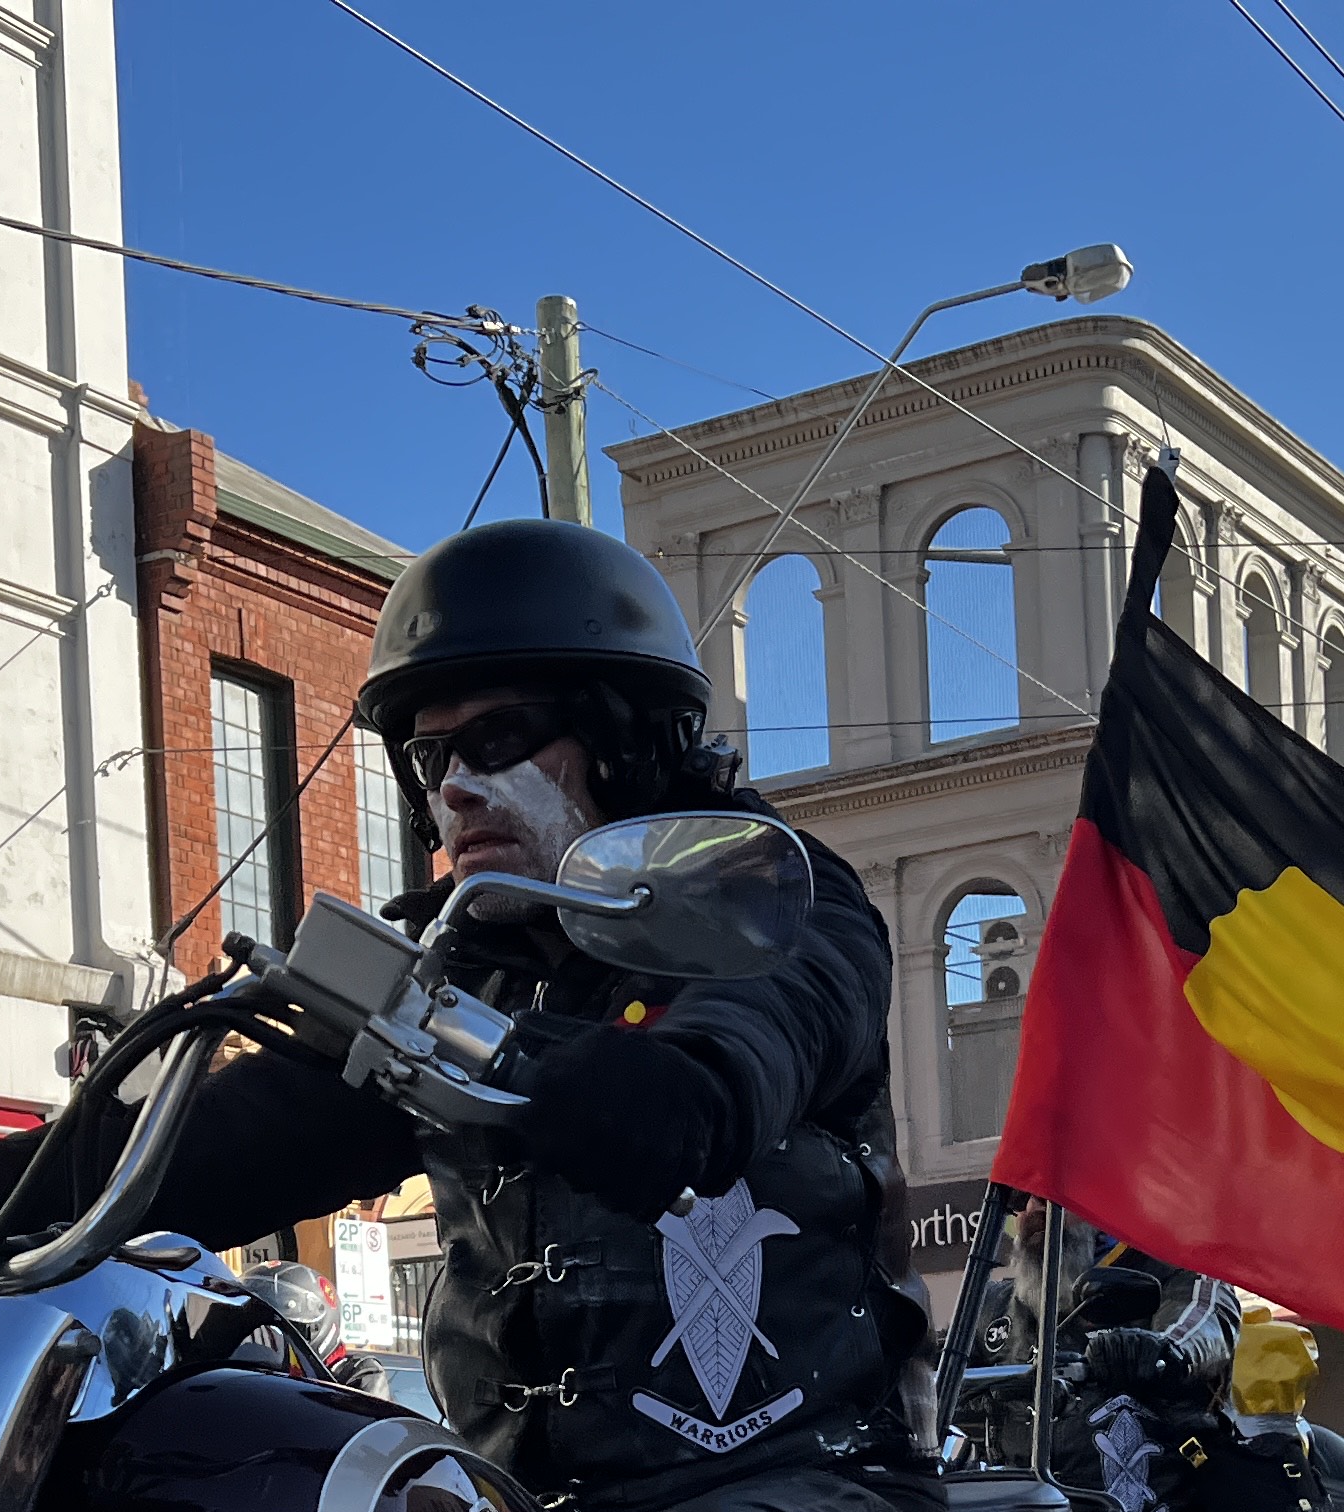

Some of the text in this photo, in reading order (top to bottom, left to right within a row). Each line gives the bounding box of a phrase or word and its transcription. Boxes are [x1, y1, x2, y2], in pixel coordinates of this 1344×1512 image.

[338, 1222, 359, 1242] 2P
[342, 1303, 362, 1323] 6P
[669, 1410, 773, 1449] WARRIORS
